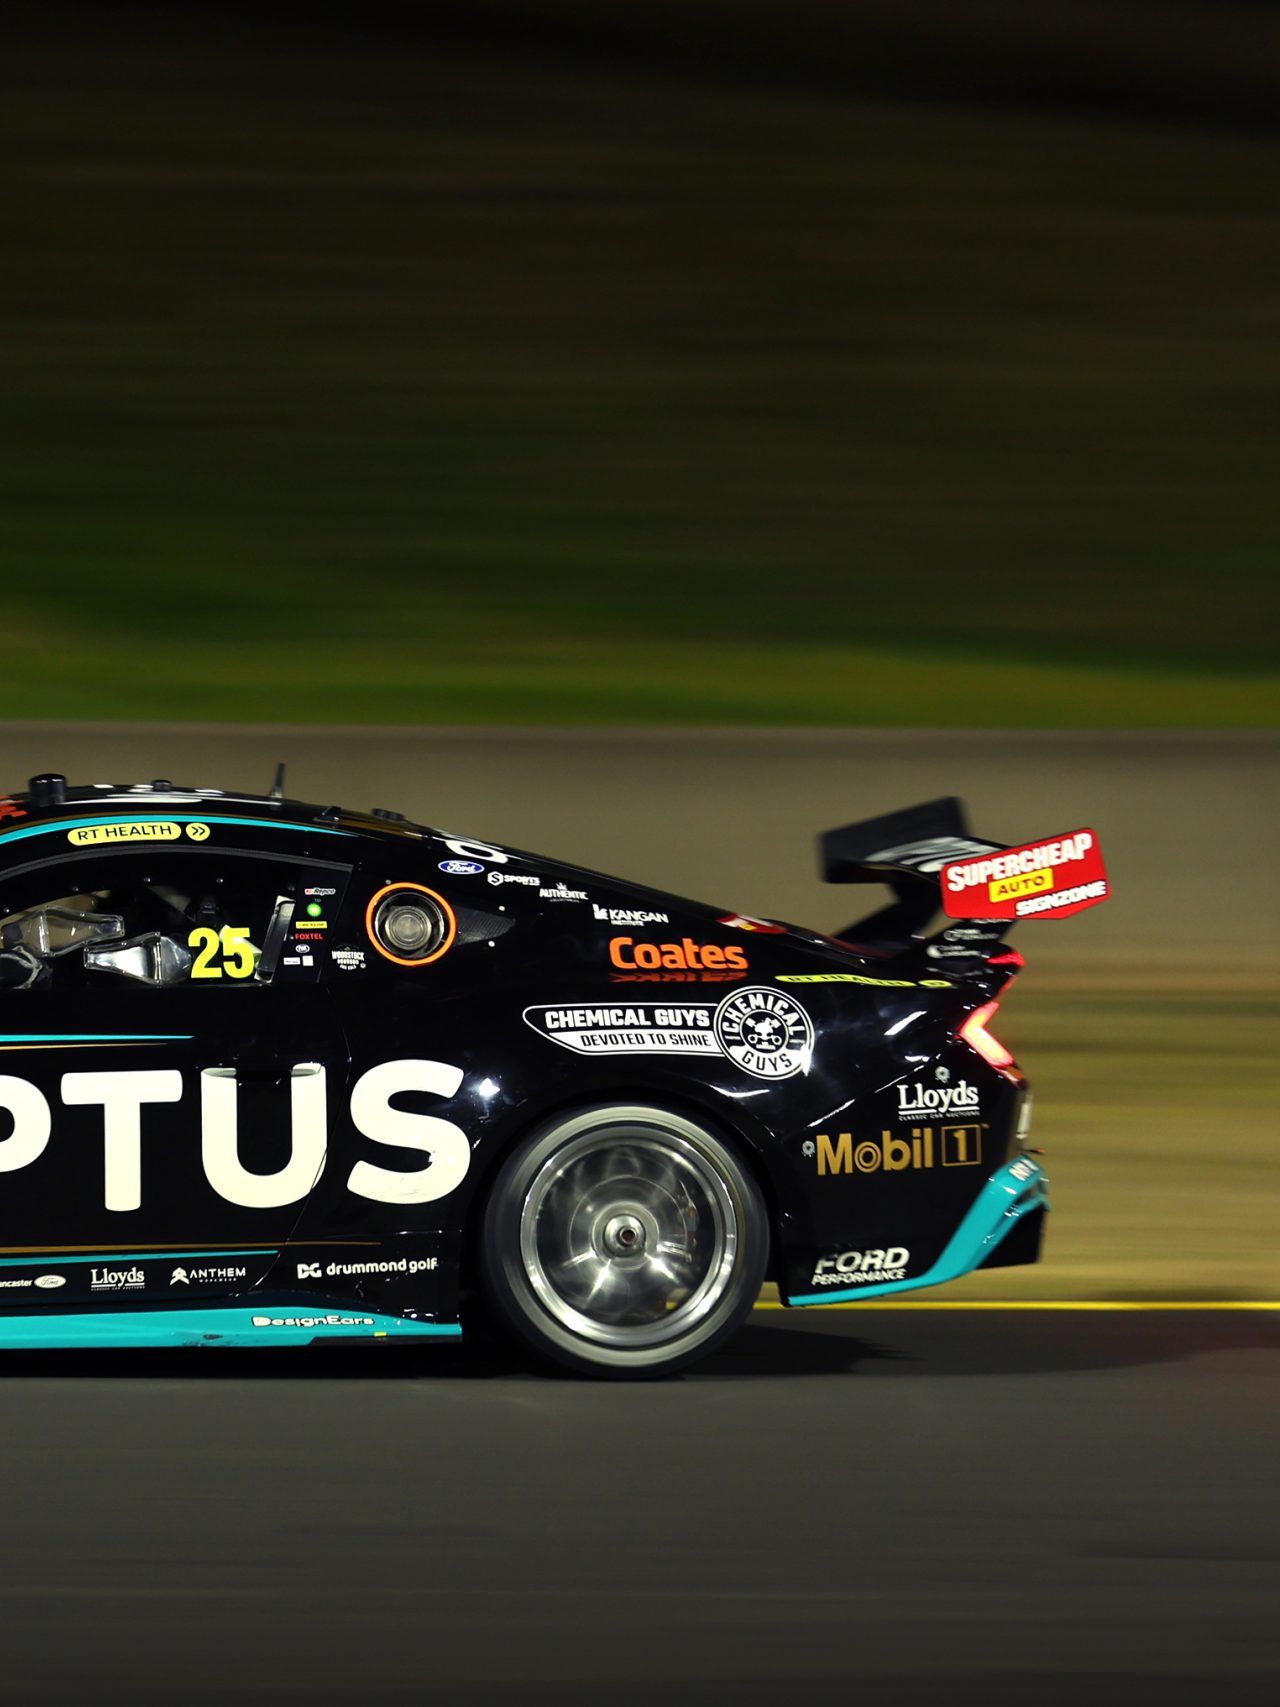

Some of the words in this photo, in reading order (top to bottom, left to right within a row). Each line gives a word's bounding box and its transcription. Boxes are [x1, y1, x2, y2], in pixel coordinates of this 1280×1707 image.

[78, 827, 99, 840] RT
[105, 824, 172, 837] HEALTH
[447, 862, 476, 873] Ford
[947, 832, 1093, 892] SUPERCHEAP
[539, 889, 589, 900] AUTHENTIC
[997, 875, 1046, 896] AUTO
[1016, 881, 1107, 917] SIGNZONE
[609, 908, 669, 923] KANGAN
[189, 927, 256, 978] 25
[609, 937, 749, 971] Coates
[822, 974, 906, 987] HEALTH
[545, 1008, 651, 1029] CHEMICAL
[655, 1010, 710, 1027] GUYS
[722, 993, 805, 1036] CHEMICAL
[581, 1033, 645, 1047] DEVOTED
[648, 1033, 667, 1046] TO
[670, 1034, 711, 1047] SHINE
[741, 1050, 792, 1073] GUYS
[896, 1080, 979, 1113] Lloyds
[816, 1127, 934, 1176] Mobil
[326, 1259, 407, 1277] drummond
[409, 1257, 438, 1273] golf
[814, 1247, 910, 1274] FORD
[91, 1267, 145, 1287] Lloyds
[189, 1267, 246, 1280] ANTHEM
[811, 1268, 907, 1286] PERFORMANCE
